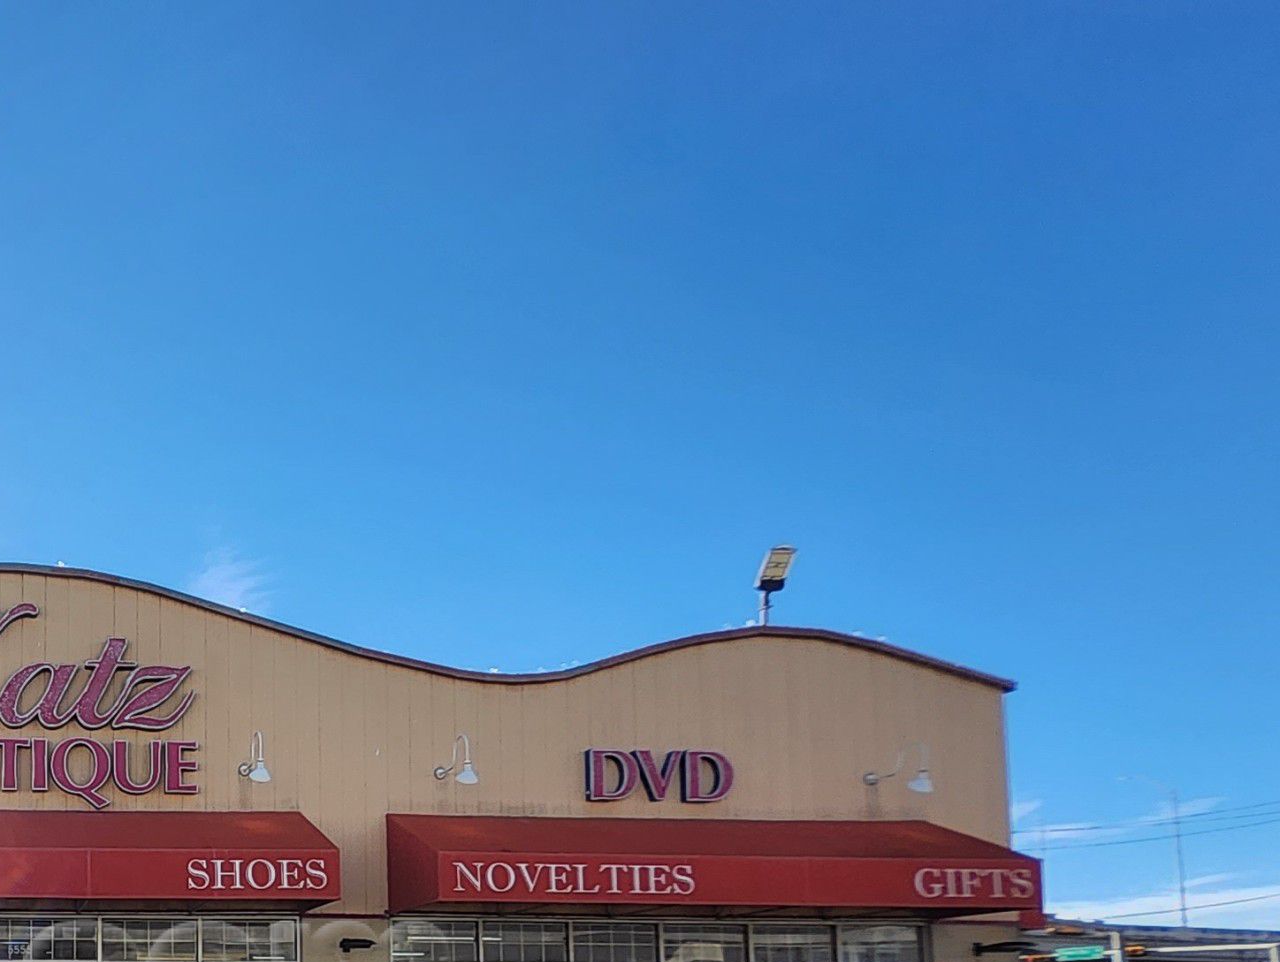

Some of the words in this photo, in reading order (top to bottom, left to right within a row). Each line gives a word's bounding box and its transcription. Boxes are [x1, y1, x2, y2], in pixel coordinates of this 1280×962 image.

[584, 747, 735, 802] DVD
[186, 859, 328, 891] SHOES
[452, 861, 696, 895] NOVELTIES
[913, 867, 1036, 900] GIFTS
